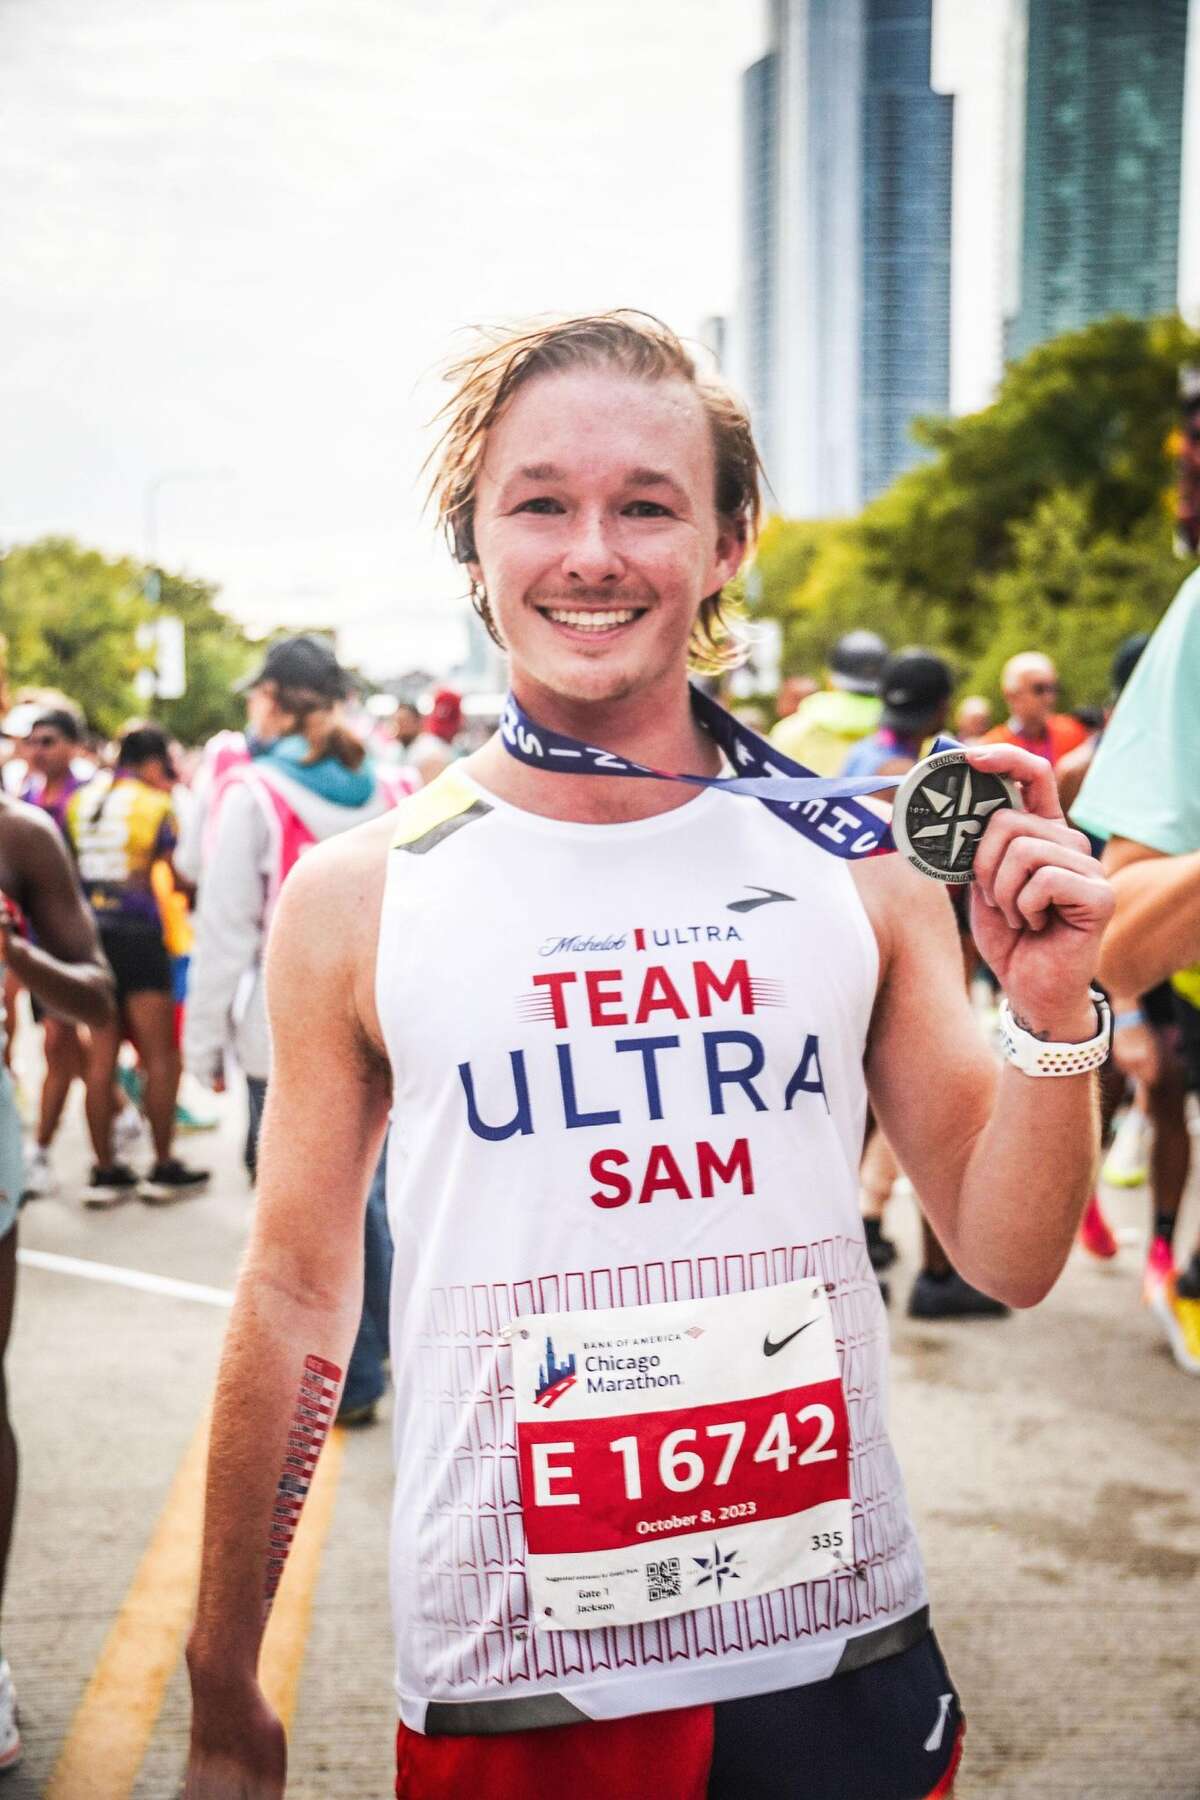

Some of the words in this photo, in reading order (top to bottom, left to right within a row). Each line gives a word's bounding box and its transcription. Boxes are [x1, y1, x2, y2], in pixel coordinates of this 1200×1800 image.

[538, 933, 627, 957] Michelob
[653, 926, 743, 947] ULTRA
[532, 959, 755, 1029] TEAM
[458, 1030, 830, 1142] ULTRA
[589, 1138, 755, 1209] SAM
[583, 1341, 612, 1350] BANK
[617, 1339, 628, 1347] OF
[633, 1334, 681, 1345] AMERICA
[585, 1355, 661, 1373] Chicago
[587, 1373, 681, 1393] Marathon
[531, 1442, 580, 1507] E
[609, 1403, 838, 1501] 16742
[636, 1514, 698, 1535] October
[700, 1509, 716, 1524] 8,
[718, 1501, 757, 1520] 2023
[811, 1531, 844, 1551] 335
[576, 1603, 614, 1615] Jackson
